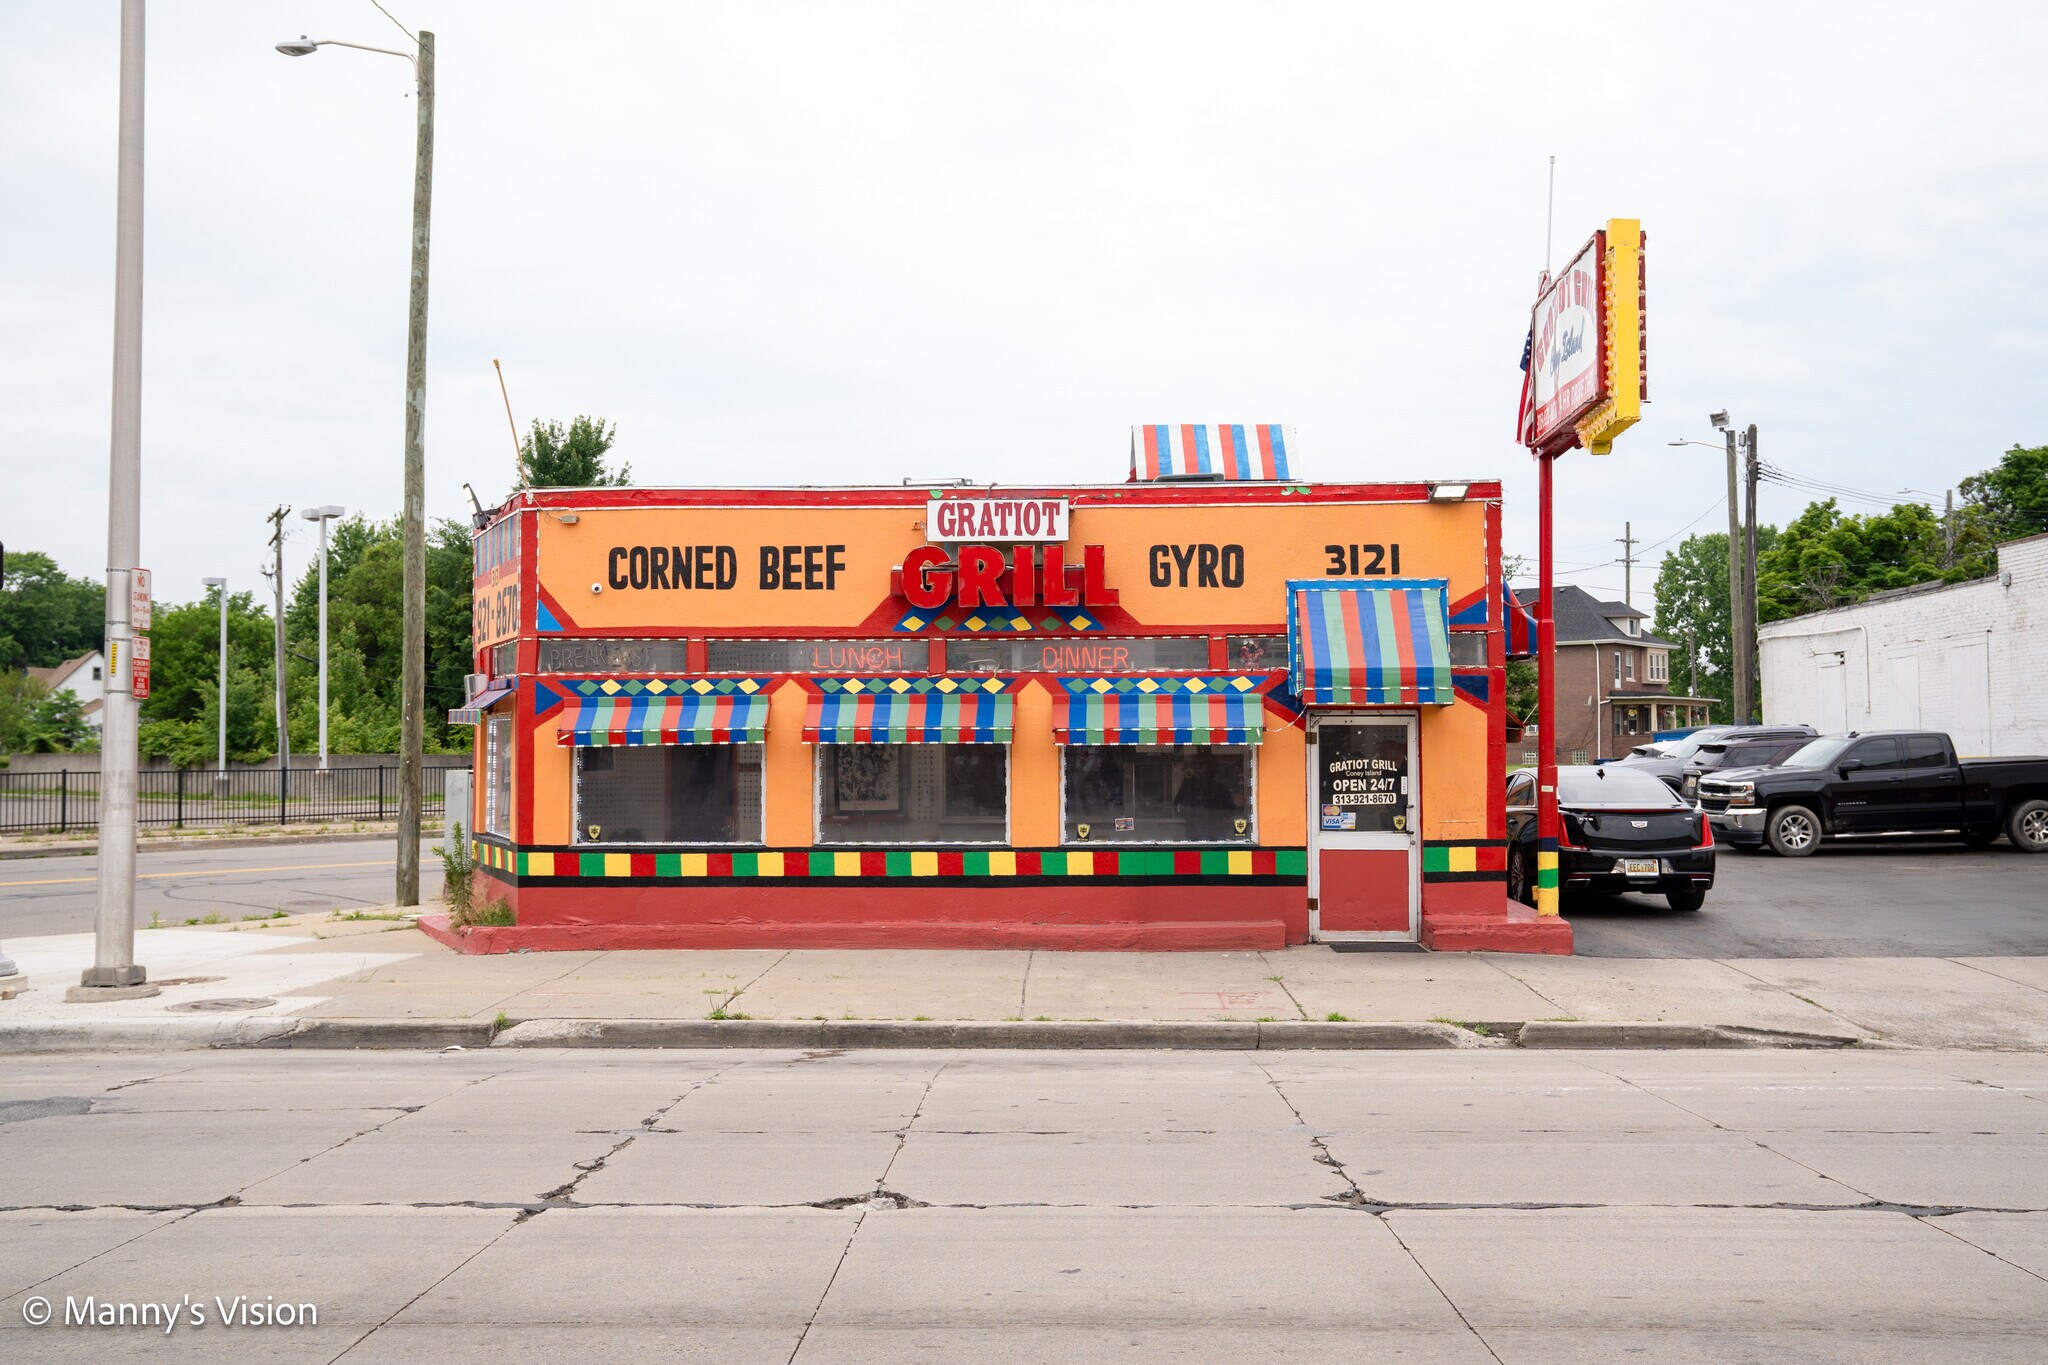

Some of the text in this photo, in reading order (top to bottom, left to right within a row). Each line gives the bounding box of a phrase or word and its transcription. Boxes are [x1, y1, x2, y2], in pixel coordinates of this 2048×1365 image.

[938, 502, 1060, 536] GRATIOT
[608, 545, 846, 590] CORNED BEEF
[1149, 544, 1244, 588] GYRO
[1324, 543, 1400, 575] 3121
[902, 545, 1120, 609] GRILL
[550, 645, 654, 669] BREAKST
[815, 647, 902, 669] LUNCH
[1043, 646, 1128, 669] DINNER
[1329, 759, 1397, 773] GRATIOT GRILL
[1333, 779, 1366, 791] OPEN
[1370, 778, 1395, 791] 24/7
[1335, 794, 1394, 804] 313-921-8670
